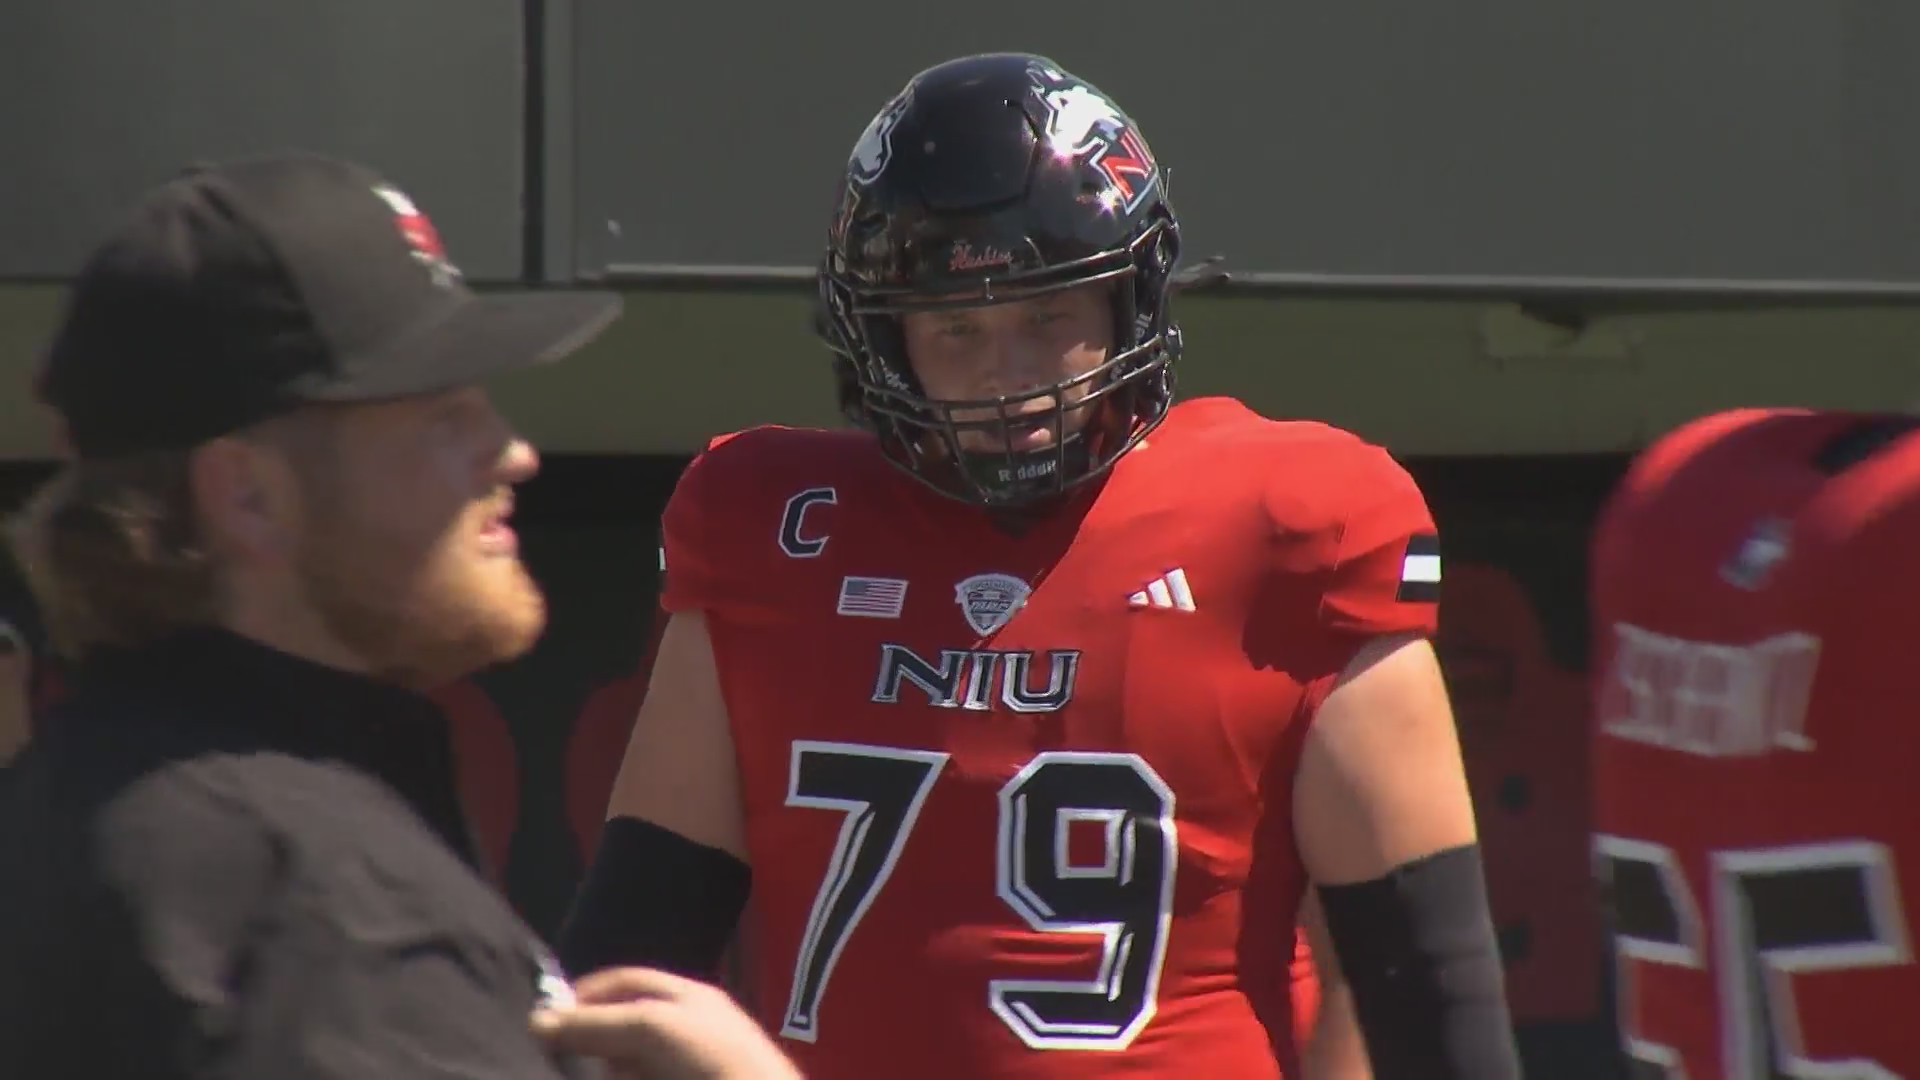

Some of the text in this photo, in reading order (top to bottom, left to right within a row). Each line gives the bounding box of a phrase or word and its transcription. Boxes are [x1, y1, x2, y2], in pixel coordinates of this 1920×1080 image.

[778, 488, 837, 557] C
[872, 644, 1081, 712] NIU
[780, 740, 1178, 1050] 79
